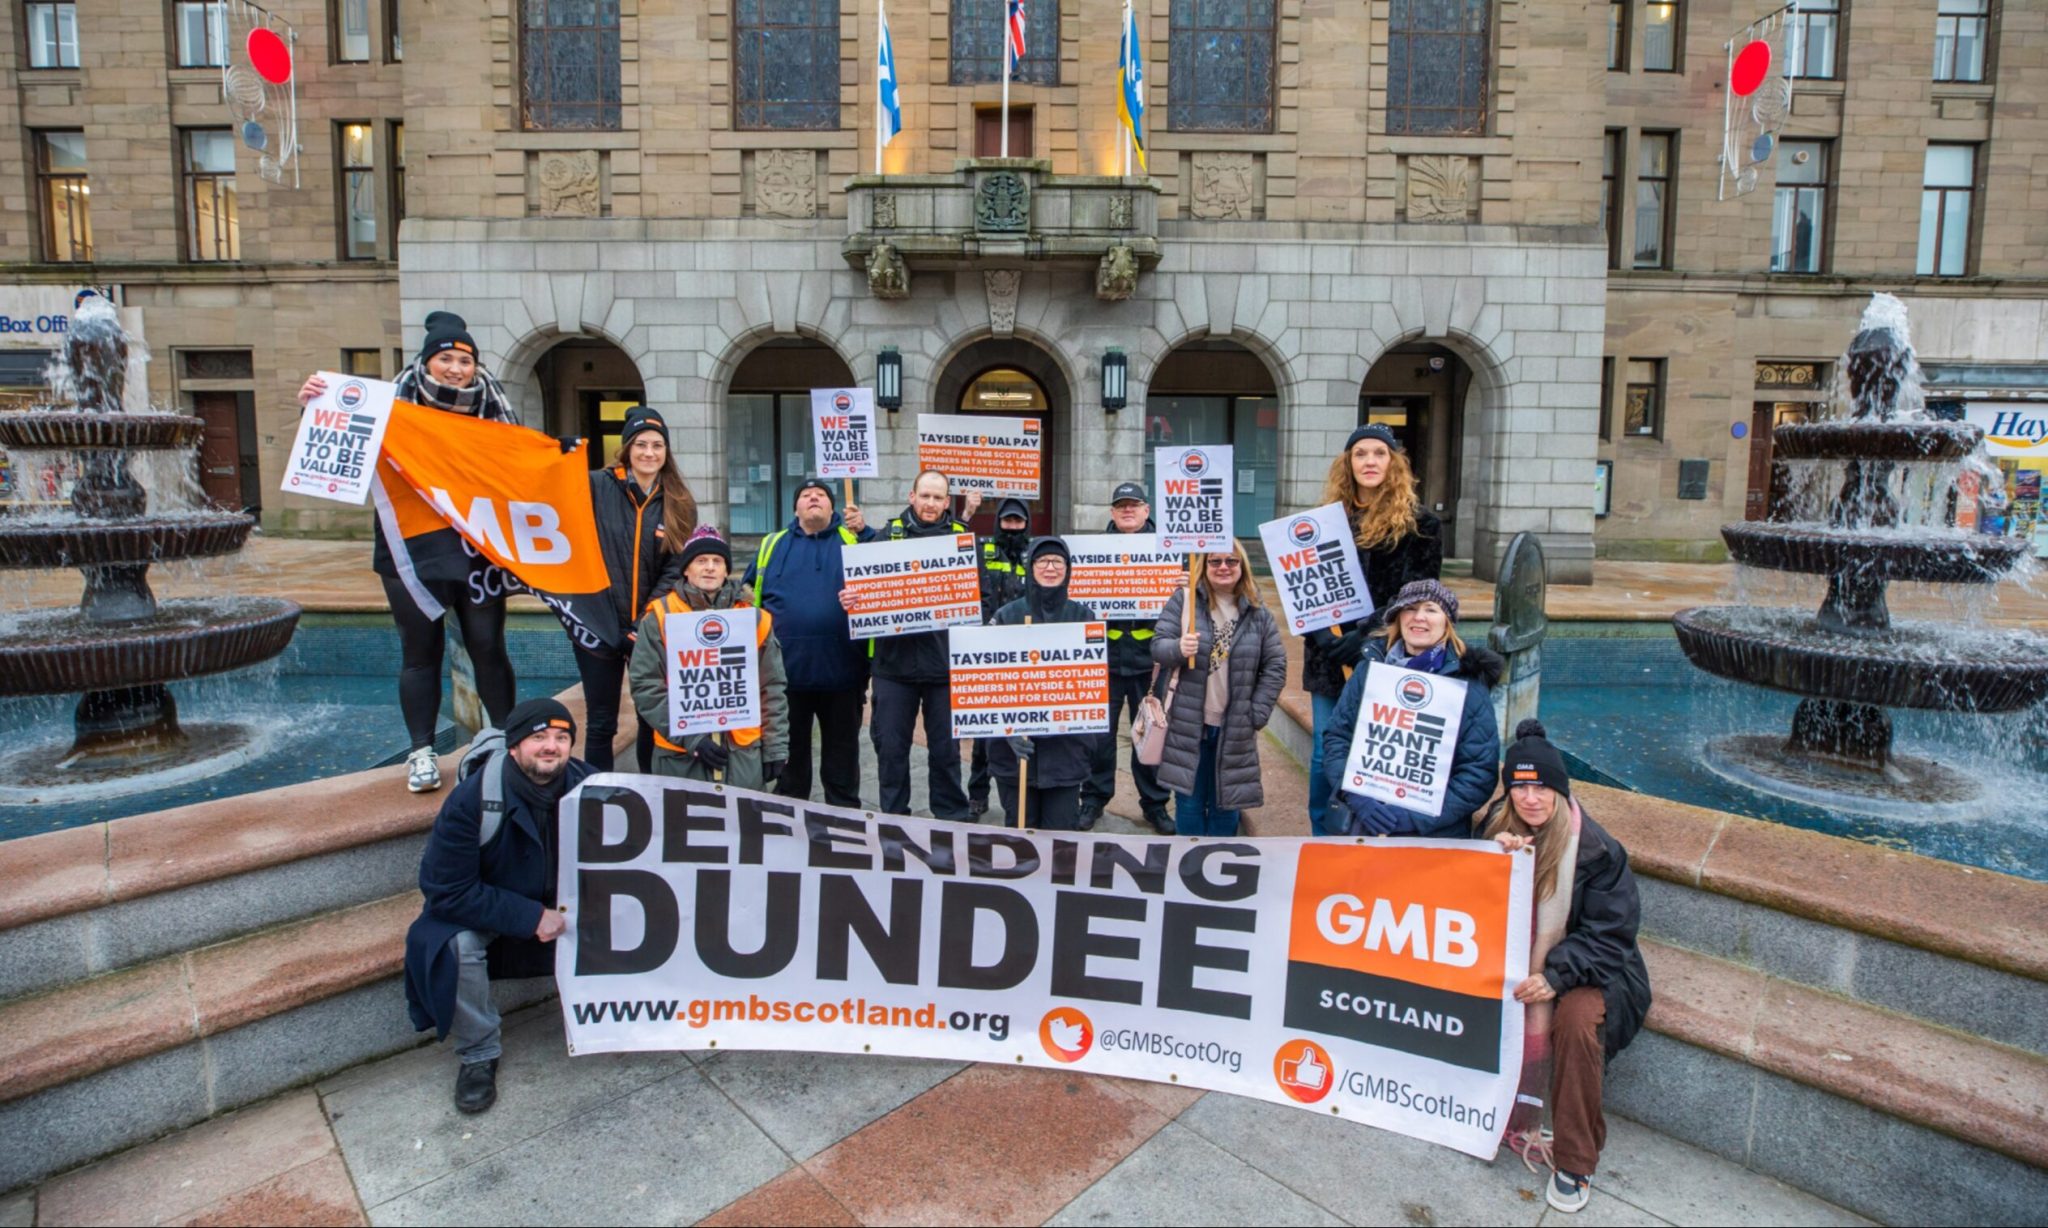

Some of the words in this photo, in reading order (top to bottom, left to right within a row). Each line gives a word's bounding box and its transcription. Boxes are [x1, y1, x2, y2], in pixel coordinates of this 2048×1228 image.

[0, 315, 32, 333] Box
[309, 427, 370, 450] WANT
[822, 430, 867, 440] WANT
[920, 434, 969, 444] TAYSIDE
[1014, 438, 1038, 447] PAY
[305, 443, 330, 459] TO
[337, 448, 366, 466] BE
[822, 442, 843, 452] TO
[849, 441, 868, 451] BE
[823, 453, 869, 461] VALUED
[300, 458, 361, 478] VALUED
[959, 479, 993, 488] WORK
[997, 481, 1037, 490] BETTER
[1165, 496, 1222, 508] WANT
[1166, 510, 1191, 522] TO
[1198, 510, 1222, 522] BE
[1166, 523, 1223, 533] VALUED
[845, 563, 901, 577] TAYSIDE
[948, 555, 974, 566] PAY
[1070, 555, 1112, 563] AYSIDE
[1156, 553, 1180, 562] PAY
[1284, 558, 1345, 586] WANT
[846, 580, 904, 592] SUPPORTING
[929, 572, 977, 583] SCOTLAND
[857, 591, 891, 601] MBERS
[904, 586, 942, 596] TAYSIDE
[953, 581, 977, 590] THEIR
[1288, 583, 1317, 600] TO
[1323, 572, 1352, 592] BE
[854, 599, 904, 610] CAMPAIGN
[906, 596, 924, 605] FOR
[925, 594, 953, 603] EQUAL
[956, 591, 974, 599] PAY
[1076, 601, 1097, 609] AKE
[1100, 601, 1136, 610] WORK
[1139, 601, 1166, 609] BETT
[1293, 588, 1356, 612] VALUED
[851, 616, 888, 628] MAKE
[891, 611, 932, 624] WORK
[934, 606, 979, 619] BETTER
[952, 651, 1017, 665] TAYSIDE
[1073, 648, 1104, 660] PAY
[679, 666, 746, 684] WANT
[952, 672, 1019, 682] SUPPORTING
[1022, 670, 1046, 680] GMB
[1049, 668, 1105, 678] SCOTLAND
[679, 684, 709, 699] TO
[719, 681, 746, 696] BE
[952, 684, 1004, 694] MEMBERS
[1006, 683, 1017, 691] IN
[1019, 681, 1064, 690] TAYSIDE
[1066, 680, 1074, 689] &
[1076, 680, 1105, 688] THEIR
[680, 696, 746, 712] VALUED
[958, 694, 1017, 704] CAMPAIGN
[1020, 694, 1040, 703] FOR
[1042, 692, 1077, 701] EQUAL
[1079, 691, 1100, 700] PAY
[954, 713, 998, 726] MAKE
[1002, 711, 1050, 723] WORK
[1053, 708, 1106, 722] BETTER
[1368, 722, 1441, 754] WANT
[1365, 739, 1396, 760] TO
[1404, 751, 1437, 772] BE
[1362, 756, 1433, 786] VALUED
[577, 785, 1261, 901] DEFENDING
[1316, 894, 1478, 968] GMB
[574, 869, 1256, 1020] DUNDEE
[1320, 989, 1464, 1036] SCOTLAND
[574, 995, 1010, 1042] www.gmbscotland.org
[1100, 1030, 1242, 1072] @GMBScotOrg
[1338, 1070, 1496, 1131] /GMBScotland
